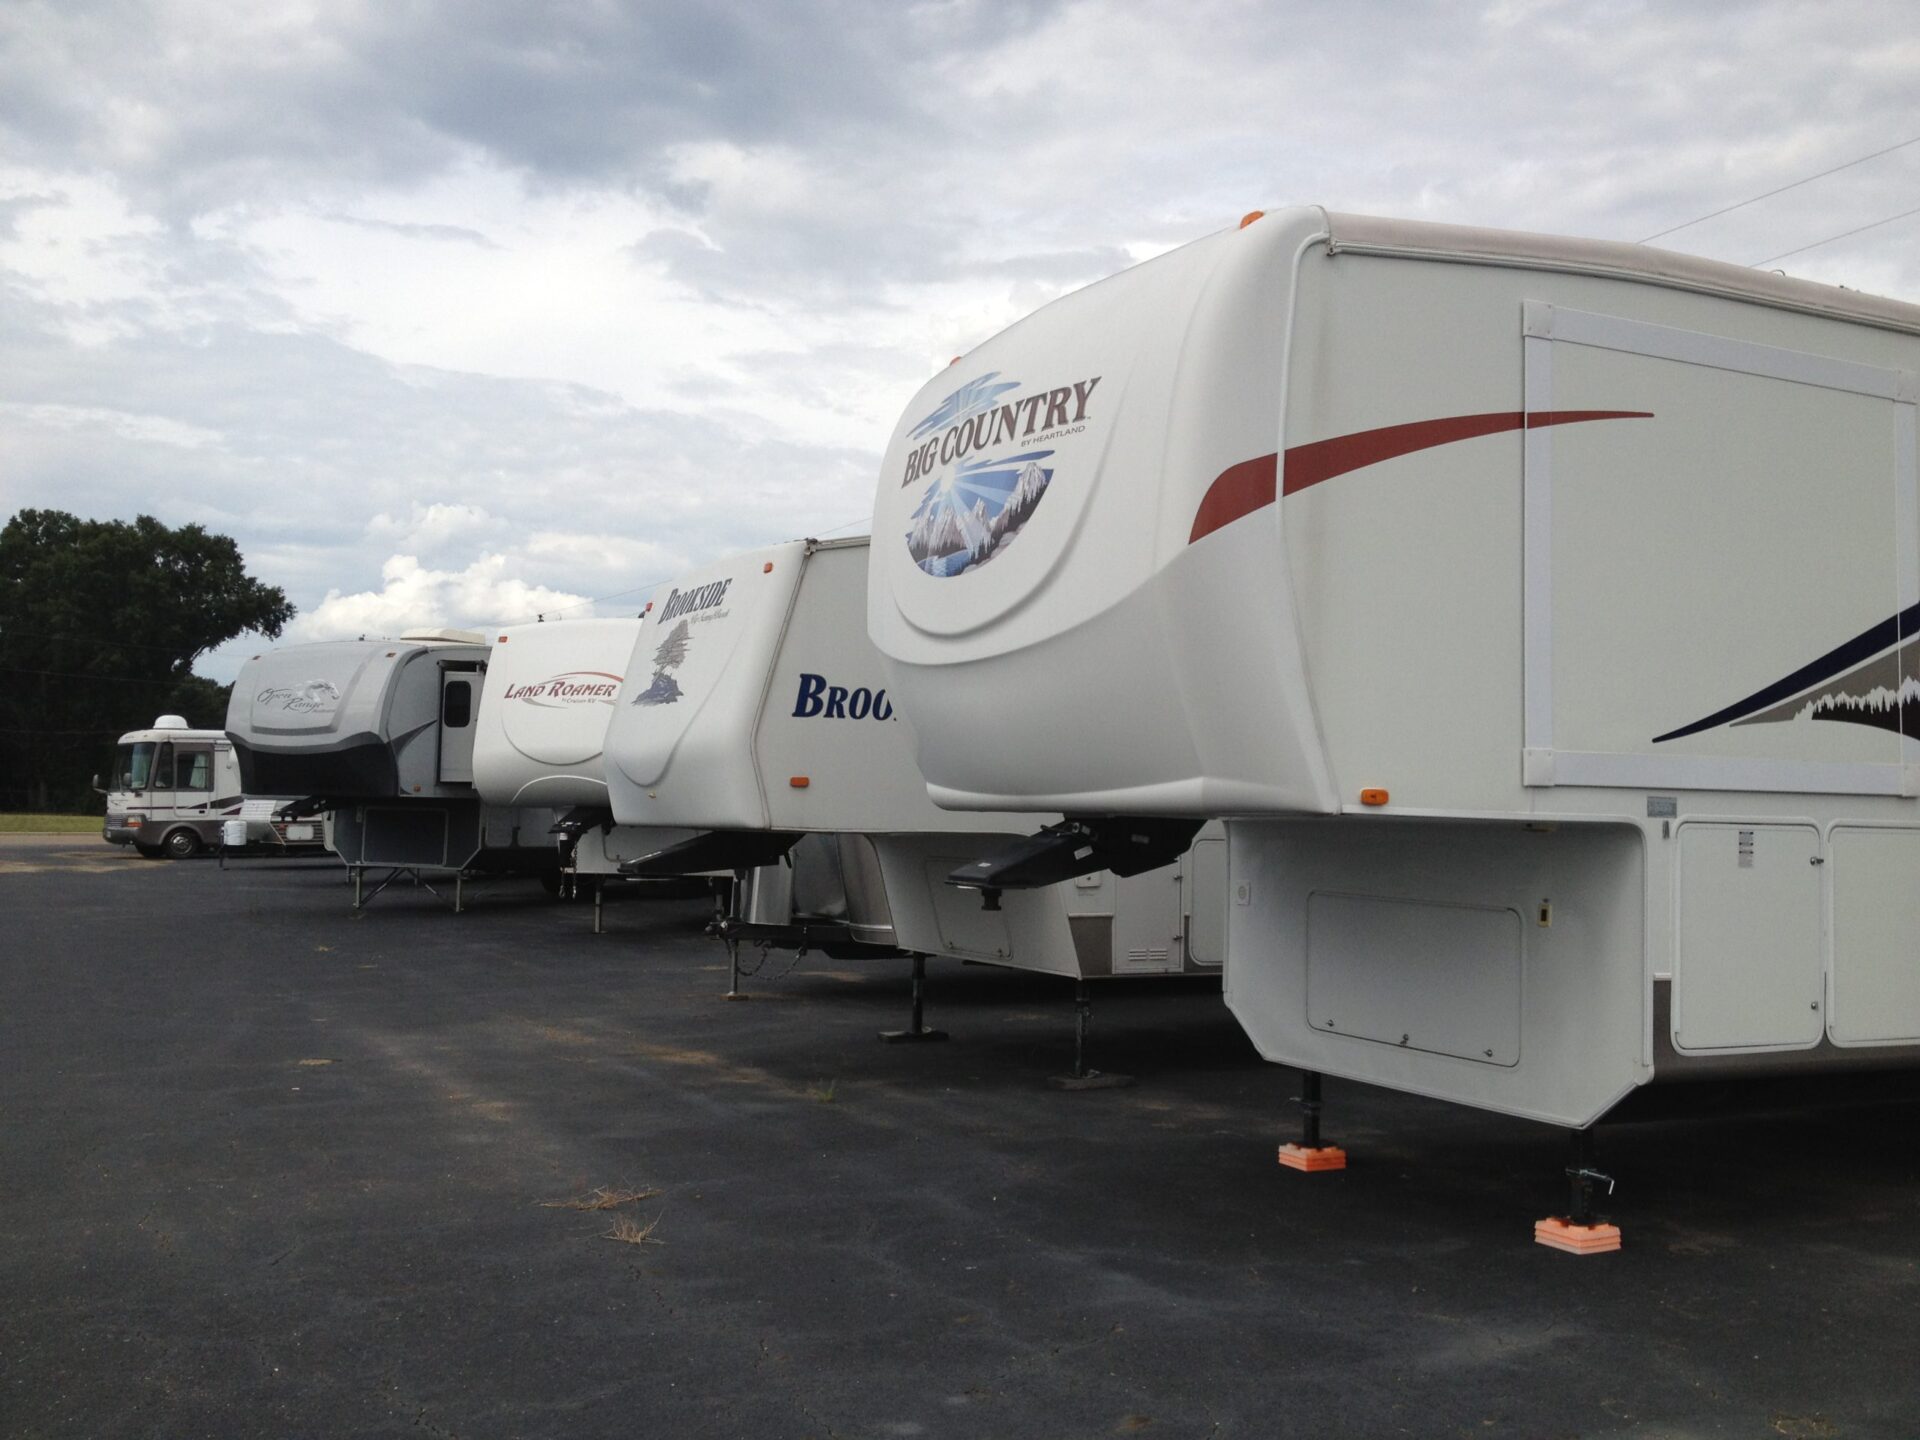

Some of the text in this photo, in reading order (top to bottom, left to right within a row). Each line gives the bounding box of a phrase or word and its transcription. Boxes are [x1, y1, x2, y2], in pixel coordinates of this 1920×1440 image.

[900, 376, 1102, 490] BIG COUNTRY
[1020, 425, 1086, 448] BY HEARTLAND
[657, 577, 733, 625] BROOKSIDE
[504, 681, 617, 699] LAND ROAMER
[791, 673, 897, 721] BROO
